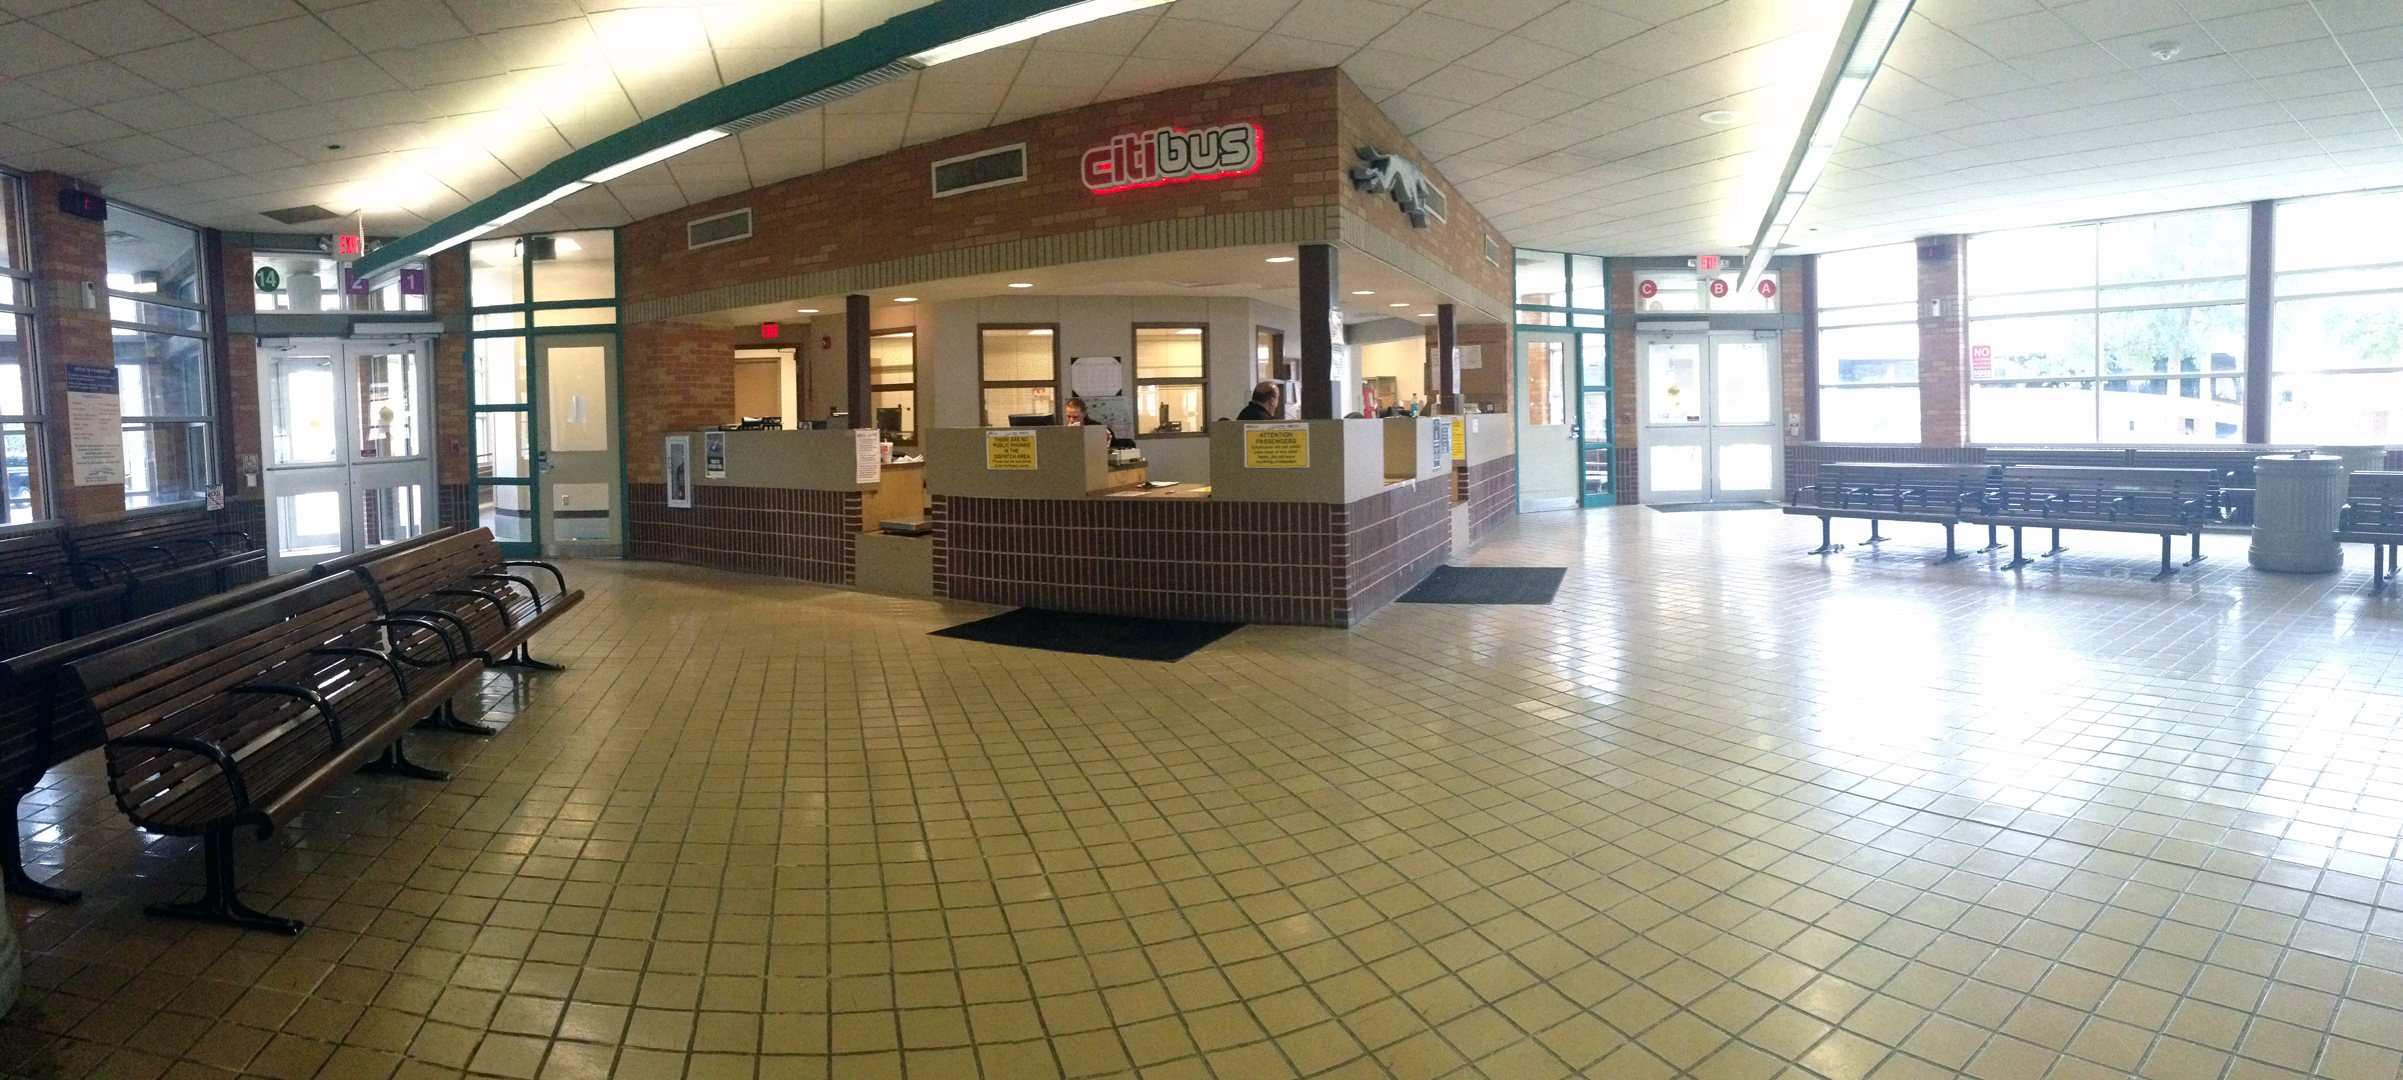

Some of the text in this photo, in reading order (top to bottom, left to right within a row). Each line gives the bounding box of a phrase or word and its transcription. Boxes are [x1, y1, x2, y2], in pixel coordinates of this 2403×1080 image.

[1083, 125, 1252, 187] citibus
[339, 236, 360, 254] EXIT
[1700, 256, 1718, 270] EXIT
[257, 270, 277, 287] 14
[406, 274, 415, 290] 1
[1642, 283, 1652, 295] C
[1714, 283, 1724, 294] B
[1761, 283, 1771, 294] A
[762, 324, 779, 338] EXIT
[1974, 347, 1990, 357] NO
